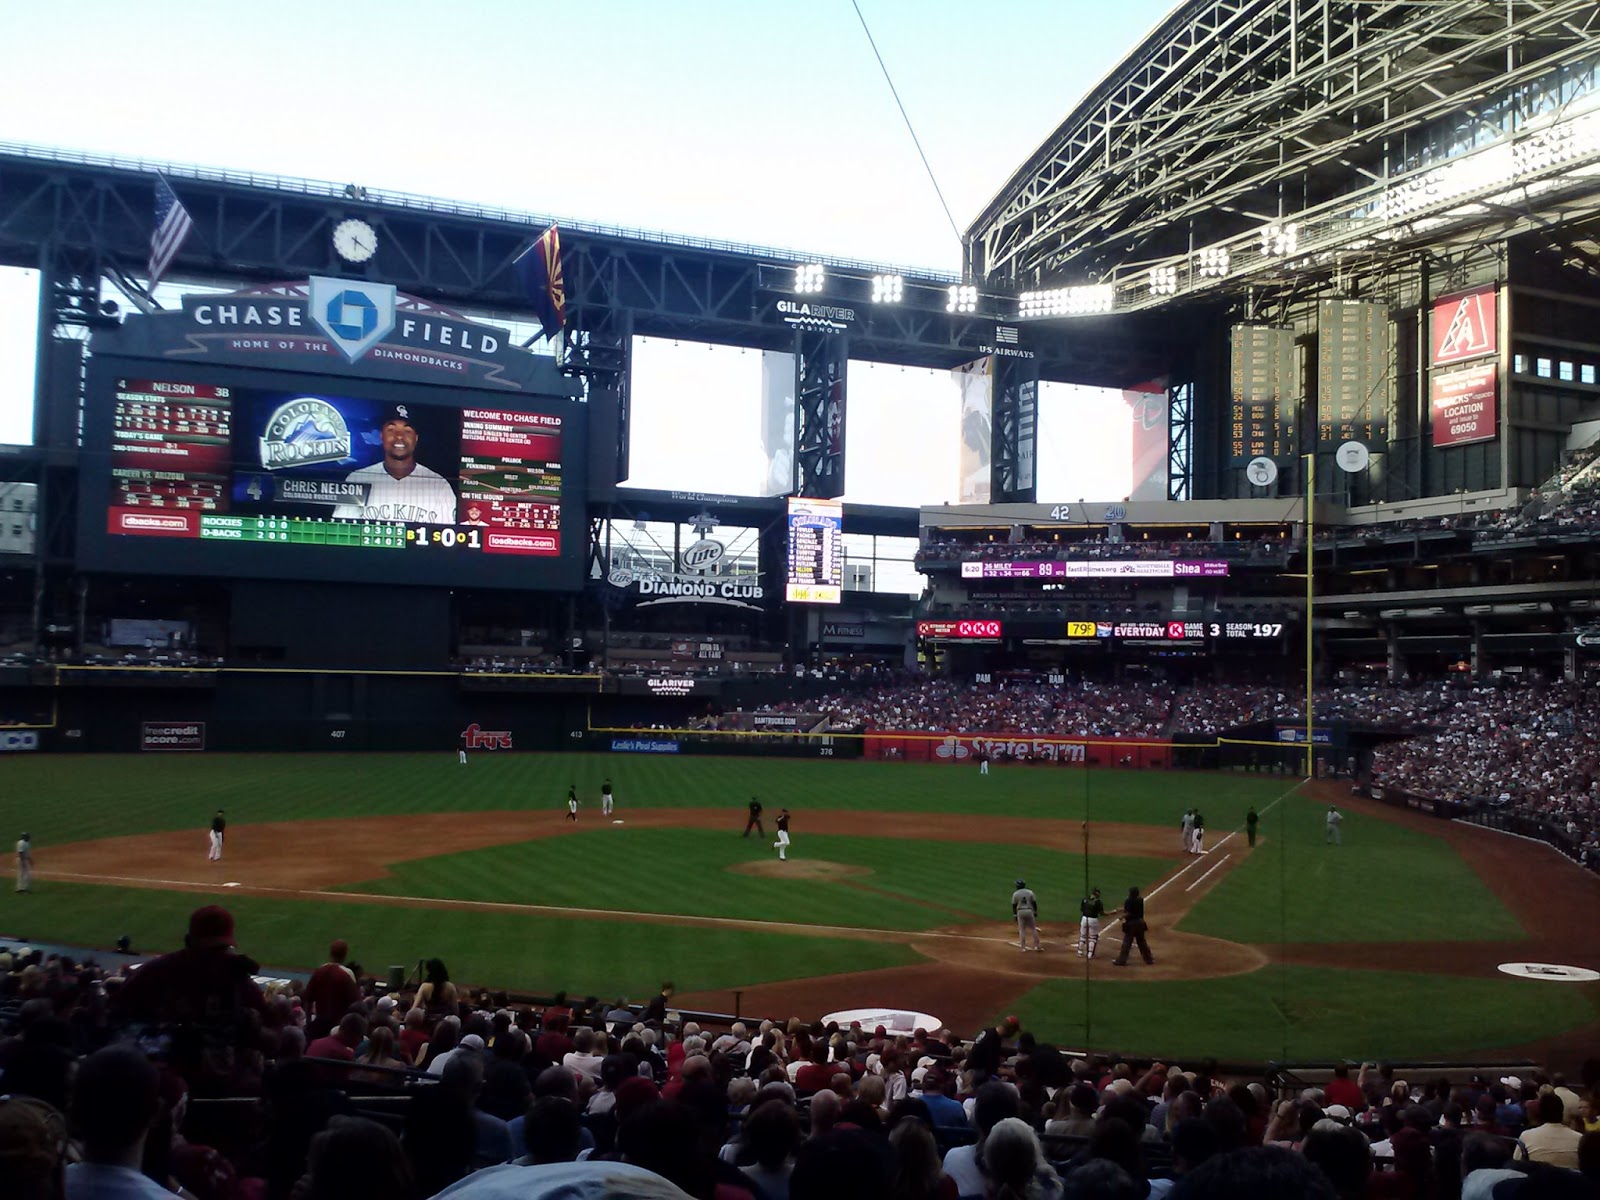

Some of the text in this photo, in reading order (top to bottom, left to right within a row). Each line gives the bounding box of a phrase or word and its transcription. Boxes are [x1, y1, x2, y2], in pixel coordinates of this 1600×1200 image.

[194, 305, 498, 354] CHASE FIELD
[792, 324, 840, 334] CASINOS
[233, 340, 463, 370] HOME OF THE DIAMONDBACKS
[994, 347, 1034, 358] AIRWAYS
[118, 380, 229, 397] 4 NELSON 3B
[1444, 402, 1483, 418] LOCATION
[272, 402, 343, 436] COLORADO
[463, 410, 501, 420] WELCOME
[514, 415, 538, 424] CHASE
[540, 417, 561, 425] FIELD
[484, 423, 514, 432] SUMMARY
[1450, 422, 1476, 435] 69050
[266, 438, 348, 462] ROCKIES
[112, 469, 140, 478] CAREER
[154, 472, 185, 480] ARIZONA
[284, 480, 317, 493] CHRIS
[321, 482, 363, 496] NELSON
[1050, 506, 1070, 520] 42
[1104, 505, 1126, 520] 20
[126, 517, 183, 527] dbacks.com
[203, 517, 243, 527] ROCKIES
[203, 529, 242, 538] D-BACKS
[407, 527, 481, 548] B 1 S 0 O 1
[491, 537, 552, 547] losdbacks.com
[692, 548, 718, 566] Lite
[1038, 563, 1052, 576] 89
[1175, 564, 1200, 574] Shea
[640, 580, 763, 598] DIAMOND CLUB
[824, 624, 835, 634] M
[1114, 627, 1165, 637] EVERYDAY
[1209, 624, 1220, 637] 3
[1253, 624, 1282, 637] 197
[1049, 674, 1064, 684] RAM
[754, 717, 796, 725] RAMTRUCKS.COM
[145, 726, 198, 735] freecredit
[612, 740, 678, 752] Leslie's Pool Supplies
[972, 736, 1084, 762] State Farm
